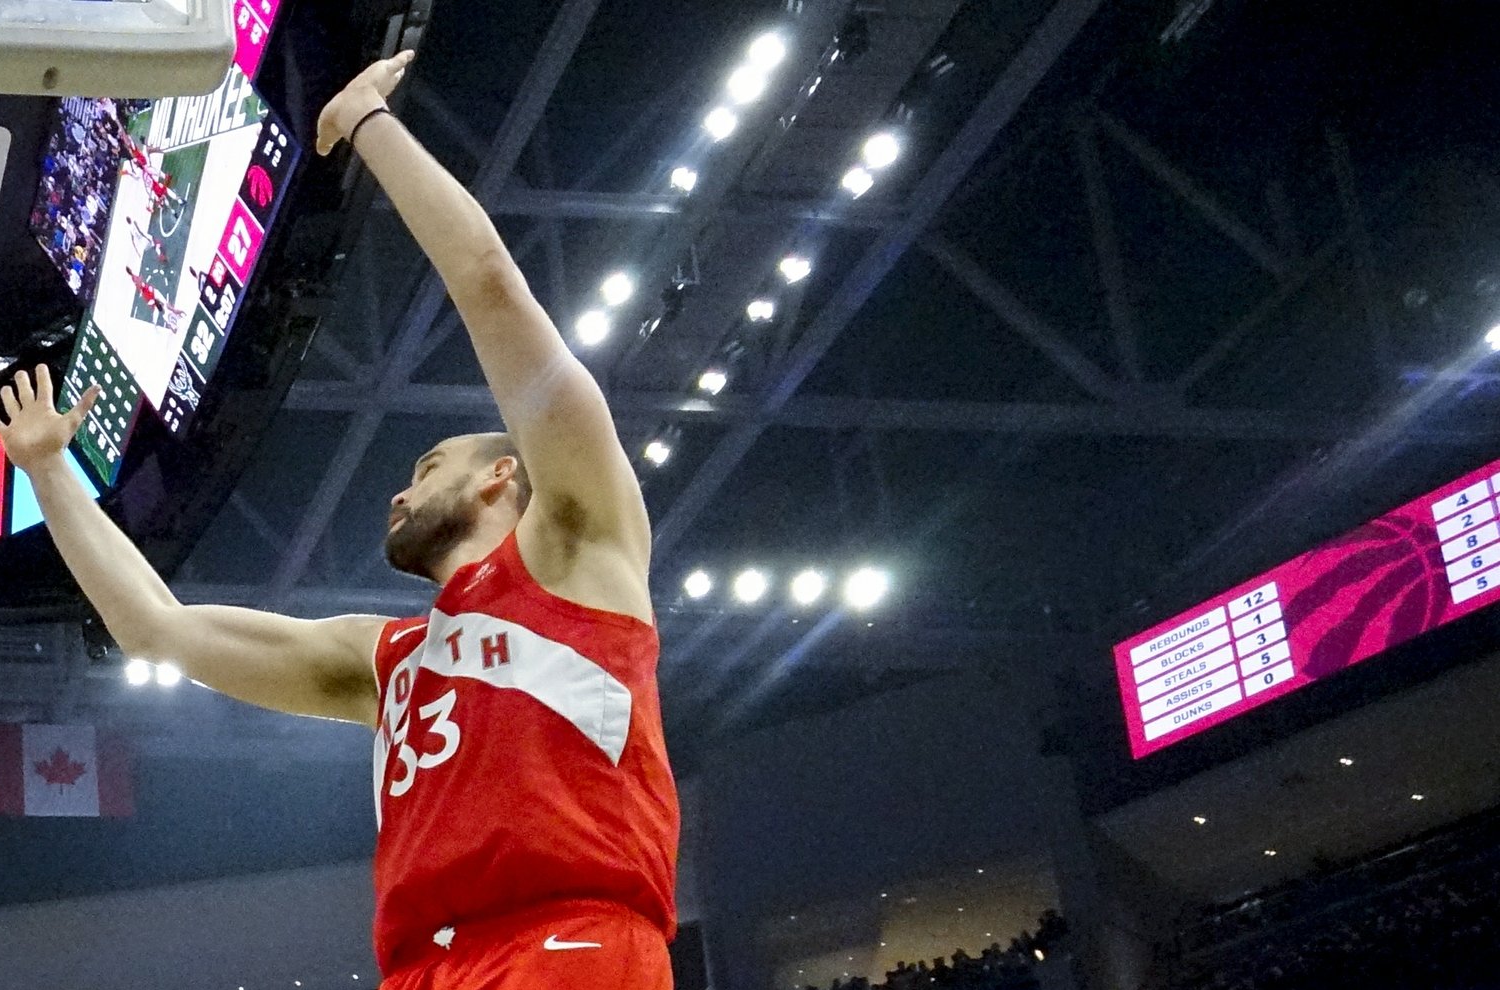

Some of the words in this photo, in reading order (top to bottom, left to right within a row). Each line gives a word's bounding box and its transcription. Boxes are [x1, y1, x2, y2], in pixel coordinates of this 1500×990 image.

[227, 216, 251, 268] 27
[191, 320, 215, 365] 32
[1456, 493, 1469, 507] 4
[1461, 514, 1474, 528] 2
[1466, 535, 1478, 549] 8
[1471, 555, 1483, 569] 6
[1476, 576, 1488, 590] 5
[1244, 591, 1264, 609] 12
[1253, 613, 1262, 625] 1
[1149, 618, 1210, 653] REBOUNDS
[1257, 633, 1266, 646] 3
[1161, 641, 1205, 668] BLOCKS
[1261, 652, 1271, 665] 5
[1164, 661, 1207, 687] STEALS
[1263, 673, 1274, 685] 0
[1166, 679, 1213, 707] ASSISTS
[1173, 701, 1213, 724] DUNKS
